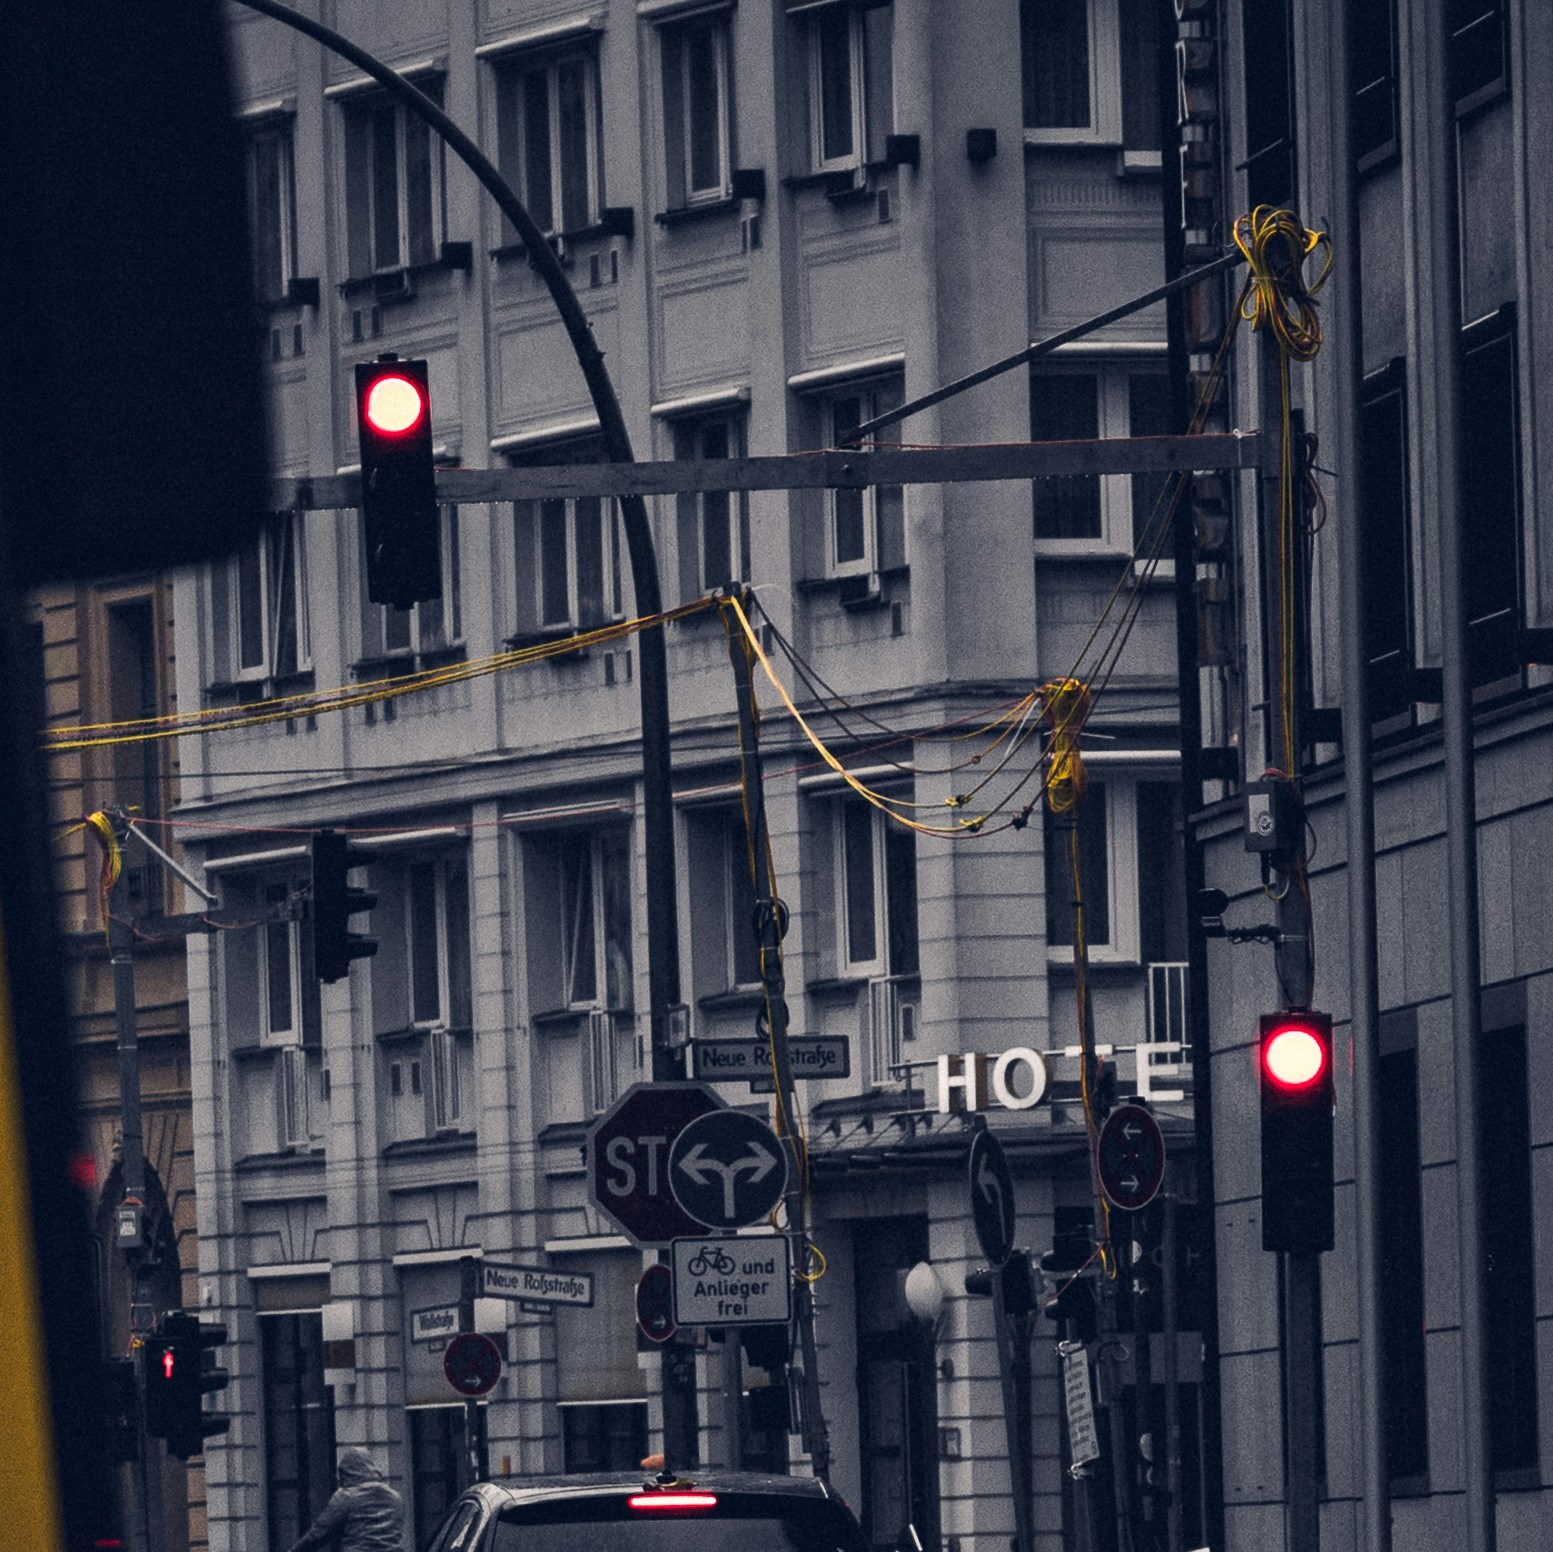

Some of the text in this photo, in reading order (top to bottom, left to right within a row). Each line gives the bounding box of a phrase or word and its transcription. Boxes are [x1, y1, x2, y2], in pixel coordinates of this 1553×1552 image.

[702, 1048, 746, 1067] Neue
[606, 1136, 667, 1197] ST
[742, 1257, 775, 1275] und
[486, 1269, 585, 1298] Neue Roßstraße
[693, 1279, 770, 1299] Anlieger
[717, 1300, 749, 1317] frei
